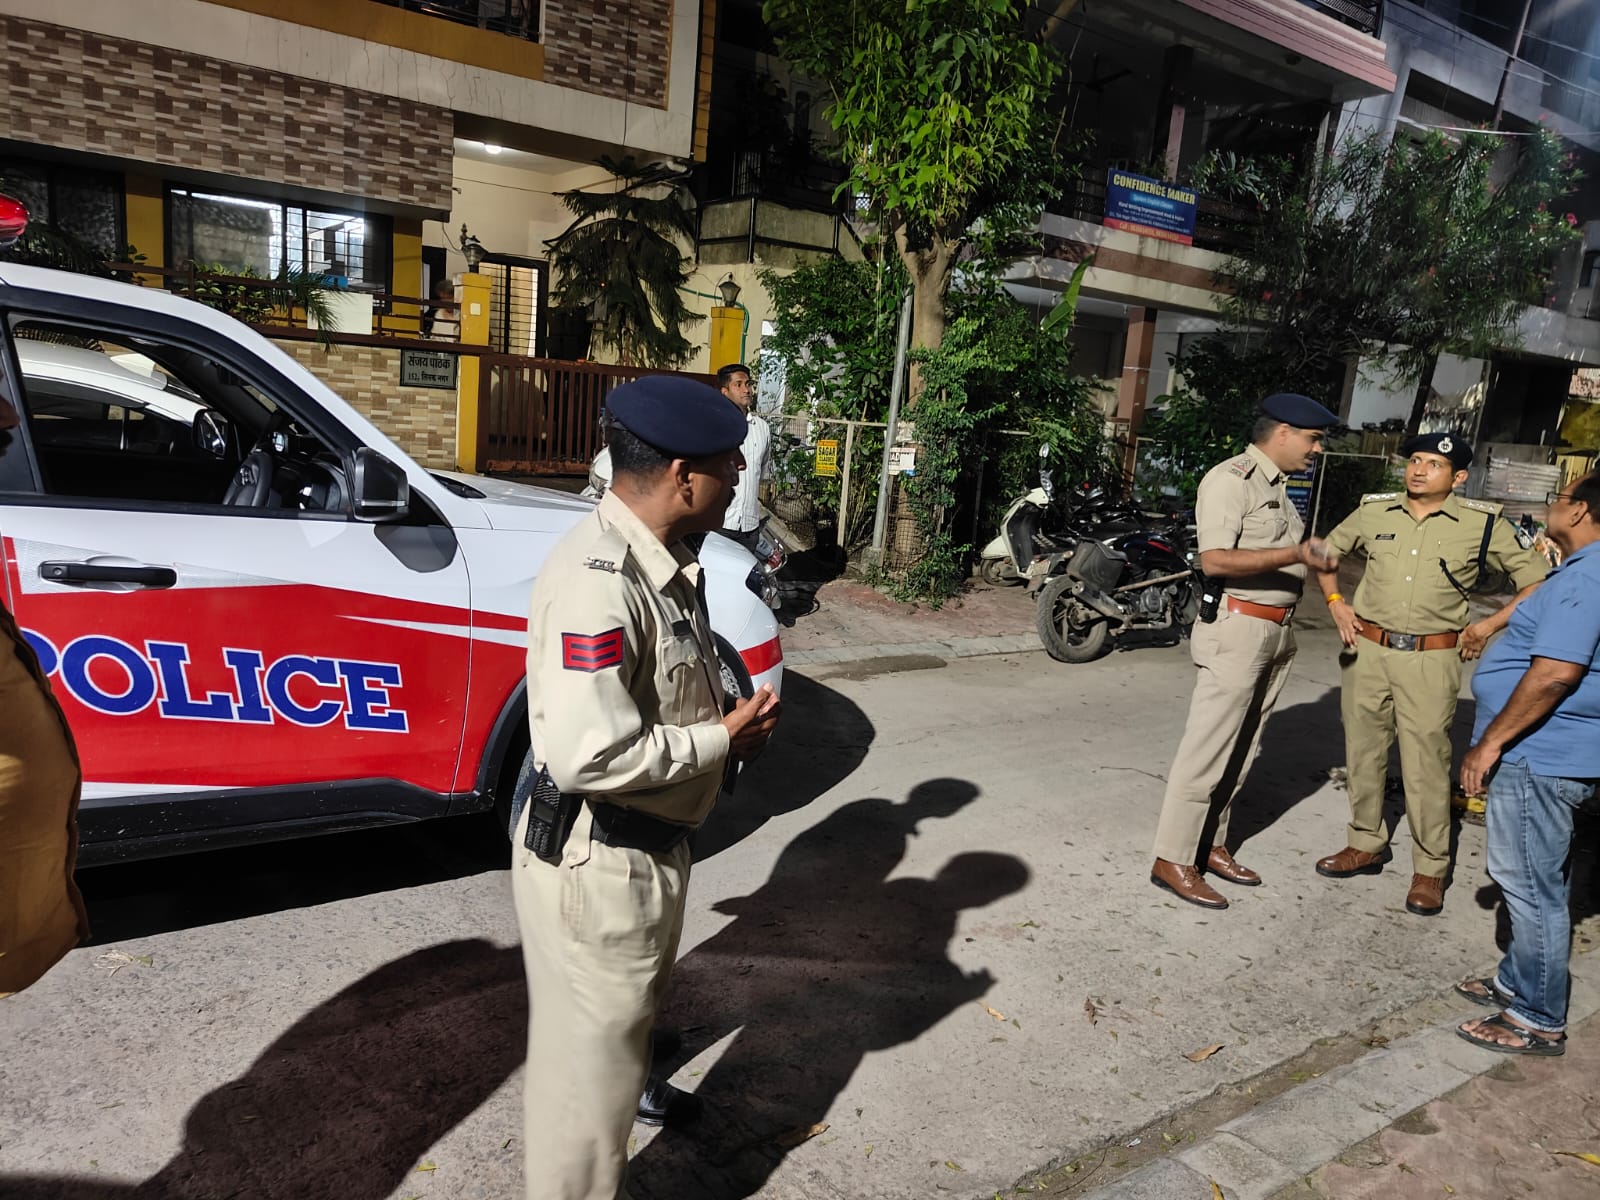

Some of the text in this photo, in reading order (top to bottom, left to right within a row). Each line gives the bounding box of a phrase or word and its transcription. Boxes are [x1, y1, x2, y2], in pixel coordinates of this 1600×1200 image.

[1113, 174, 1196, 205] CONFIDENCE MAKER
[408, 352, 428, 368] संजय
[429, 357, 451, 369] पाठक
